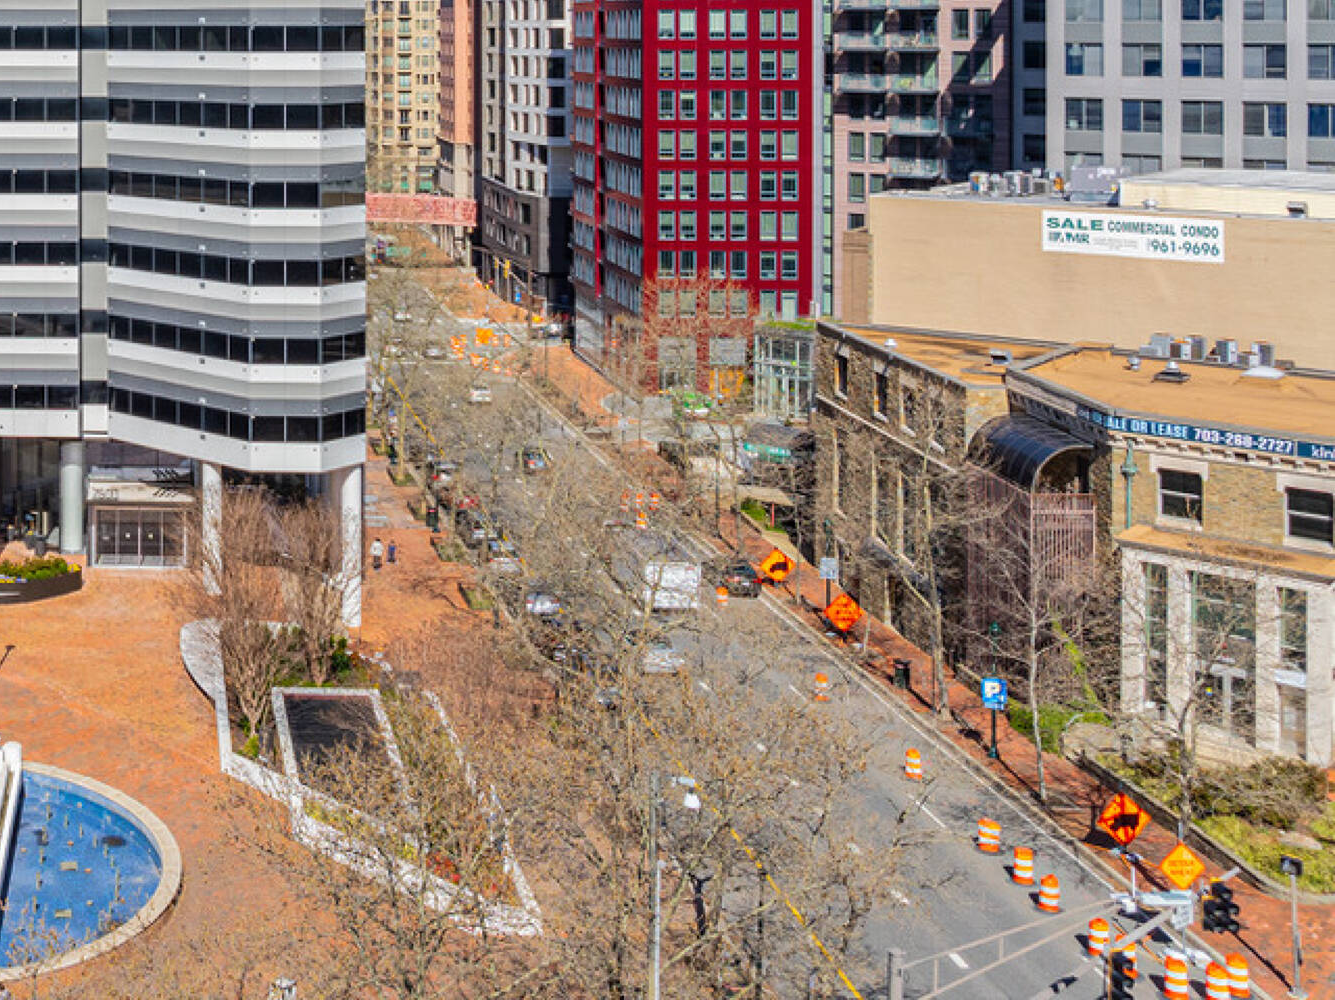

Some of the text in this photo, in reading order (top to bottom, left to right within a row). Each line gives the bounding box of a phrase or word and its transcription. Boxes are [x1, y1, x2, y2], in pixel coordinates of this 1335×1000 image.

[1046, 217, 1219, 239] SALE COMMERCIAL CONDO
[1151, 421, 1189, 439] LEASE
[984, 680, 1001, 698] P
